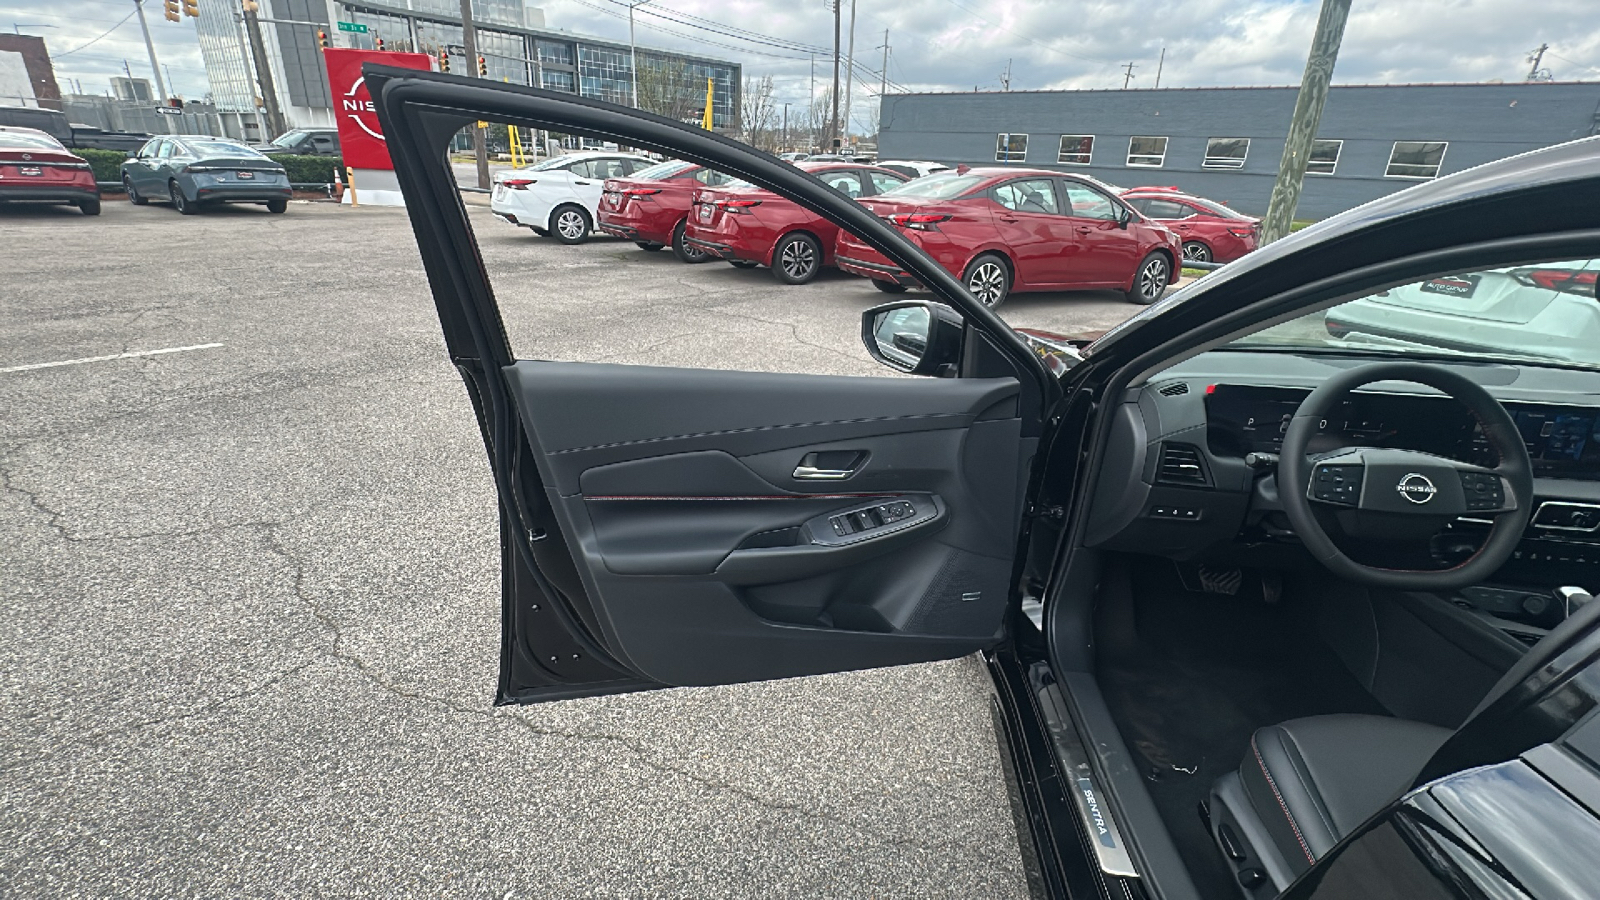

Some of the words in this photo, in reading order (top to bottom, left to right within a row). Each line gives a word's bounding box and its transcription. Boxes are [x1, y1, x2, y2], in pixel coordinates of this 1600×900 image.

[343, 99, 377, 112] NIS
[1426, 282, 1446, 291] AUTO
[1446, 285, 1469, 293] GROUP
[1396, 485, 1437, 493] NISSAN
[1083, 789, 1108, 835] SENTRA
